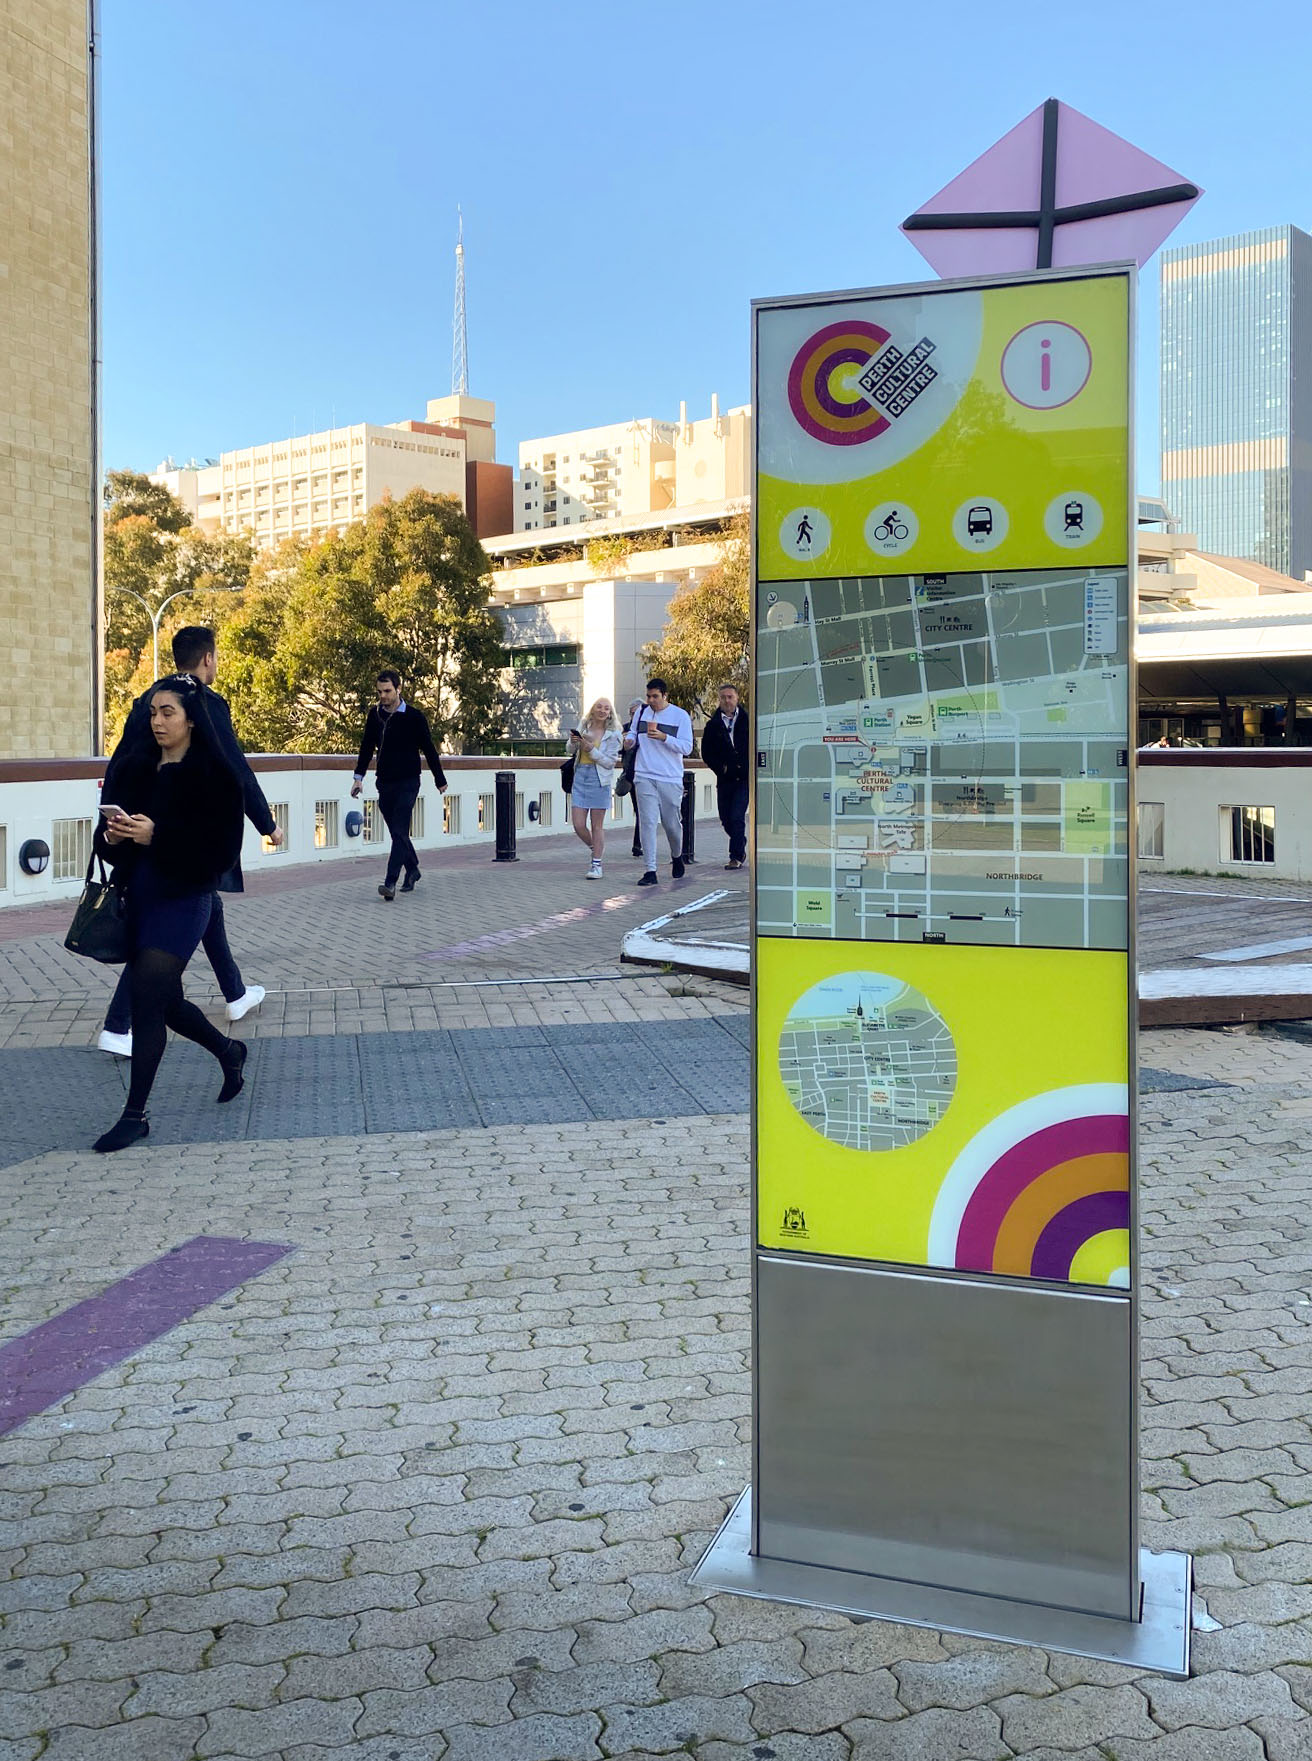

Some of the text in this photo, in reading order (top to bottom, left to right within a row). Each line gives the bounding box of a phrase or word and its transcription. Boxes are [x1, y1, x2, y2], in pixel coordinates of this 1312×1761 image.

[860, 347, 901, 390] PERTH
[875, 342, 934, 402] CULTURAL
[889, 365, 935, 415] CENTRE
[985, 872, 1044, 881] NORTHBRIDGE
